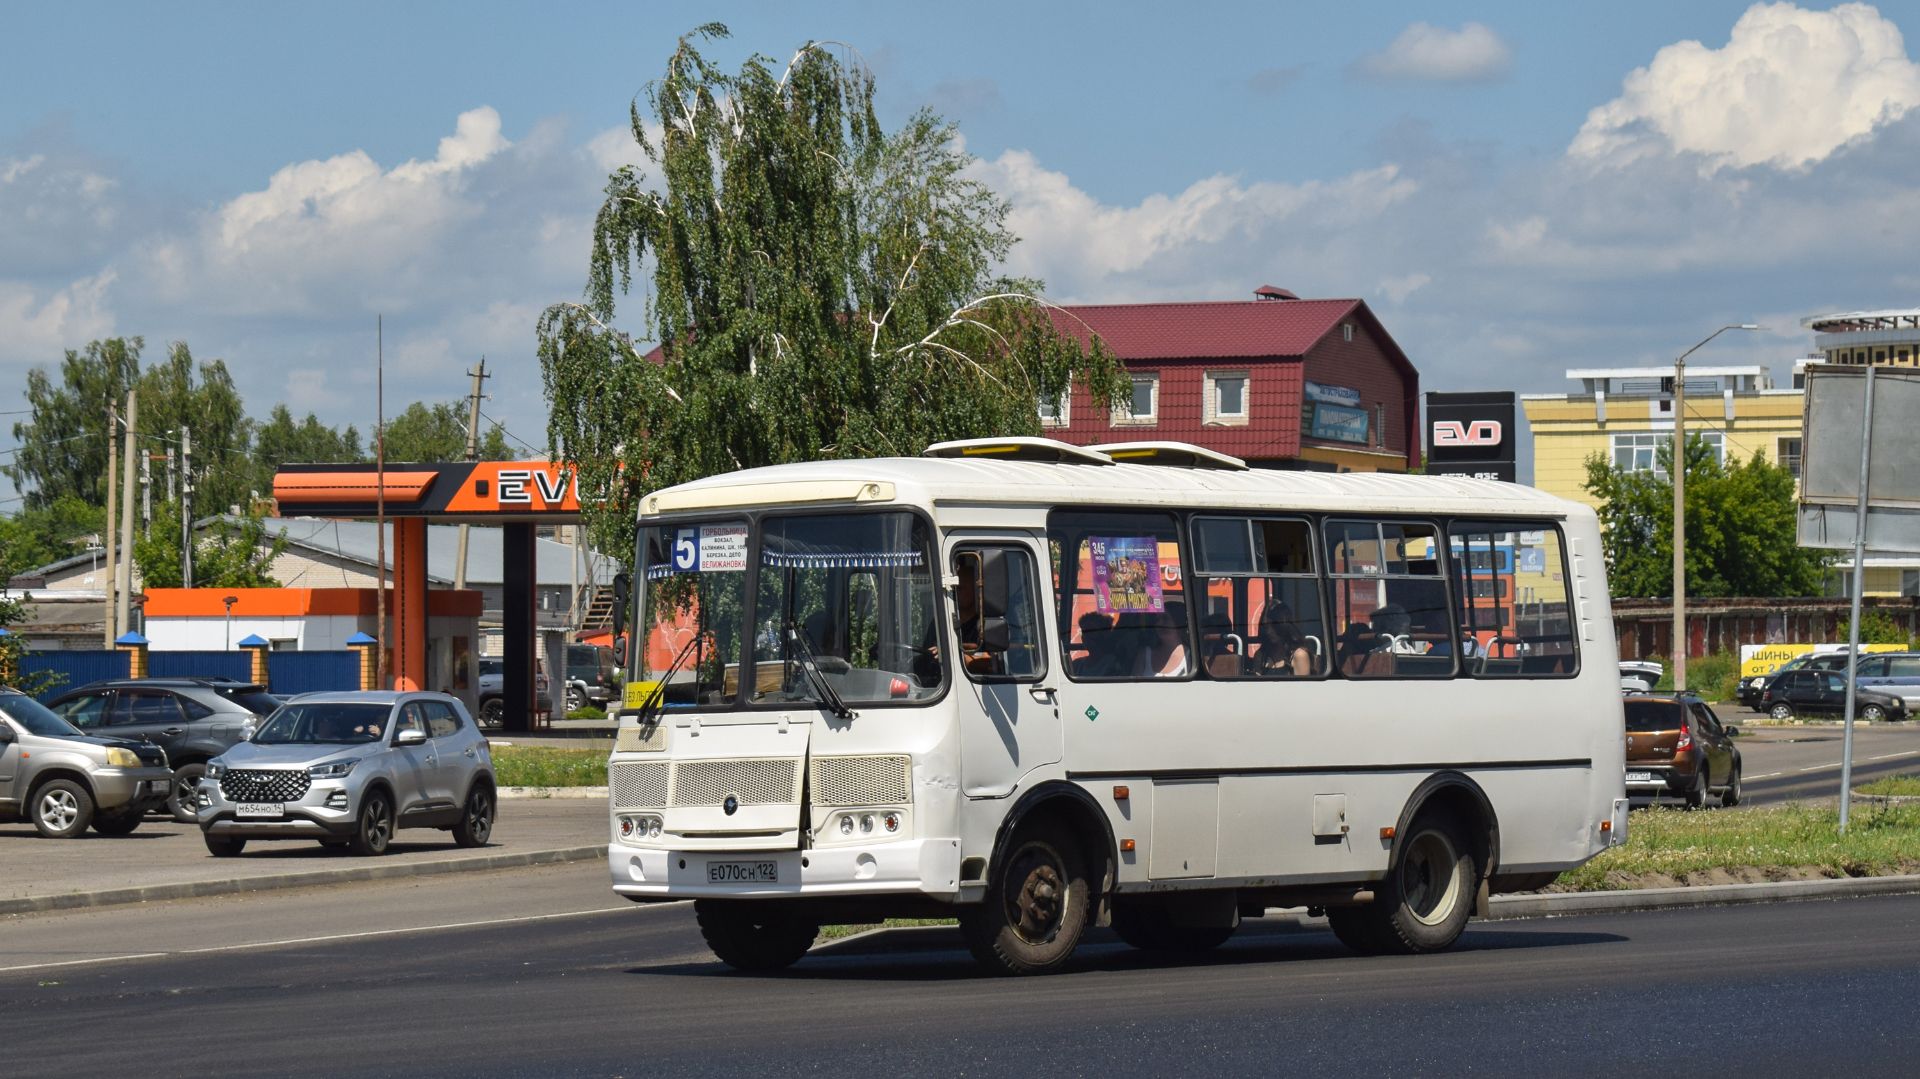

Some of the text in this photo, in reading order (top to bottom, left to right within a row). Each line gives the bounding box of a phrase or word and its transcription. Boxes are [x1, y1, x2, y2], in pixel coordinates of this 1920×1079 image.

[1433, 420, 1502, 446] EVO
[702, 527, 747, 537] ГОРБОЛЬНИЦА
[676, 529, 696, 569] 5
[702, 559, 746, 569] ВЕЛИЖАНОВКА
[1752, 651, 1793, 661] ШИНЫ
[711, 863, 775, 880] Е070СН 122
